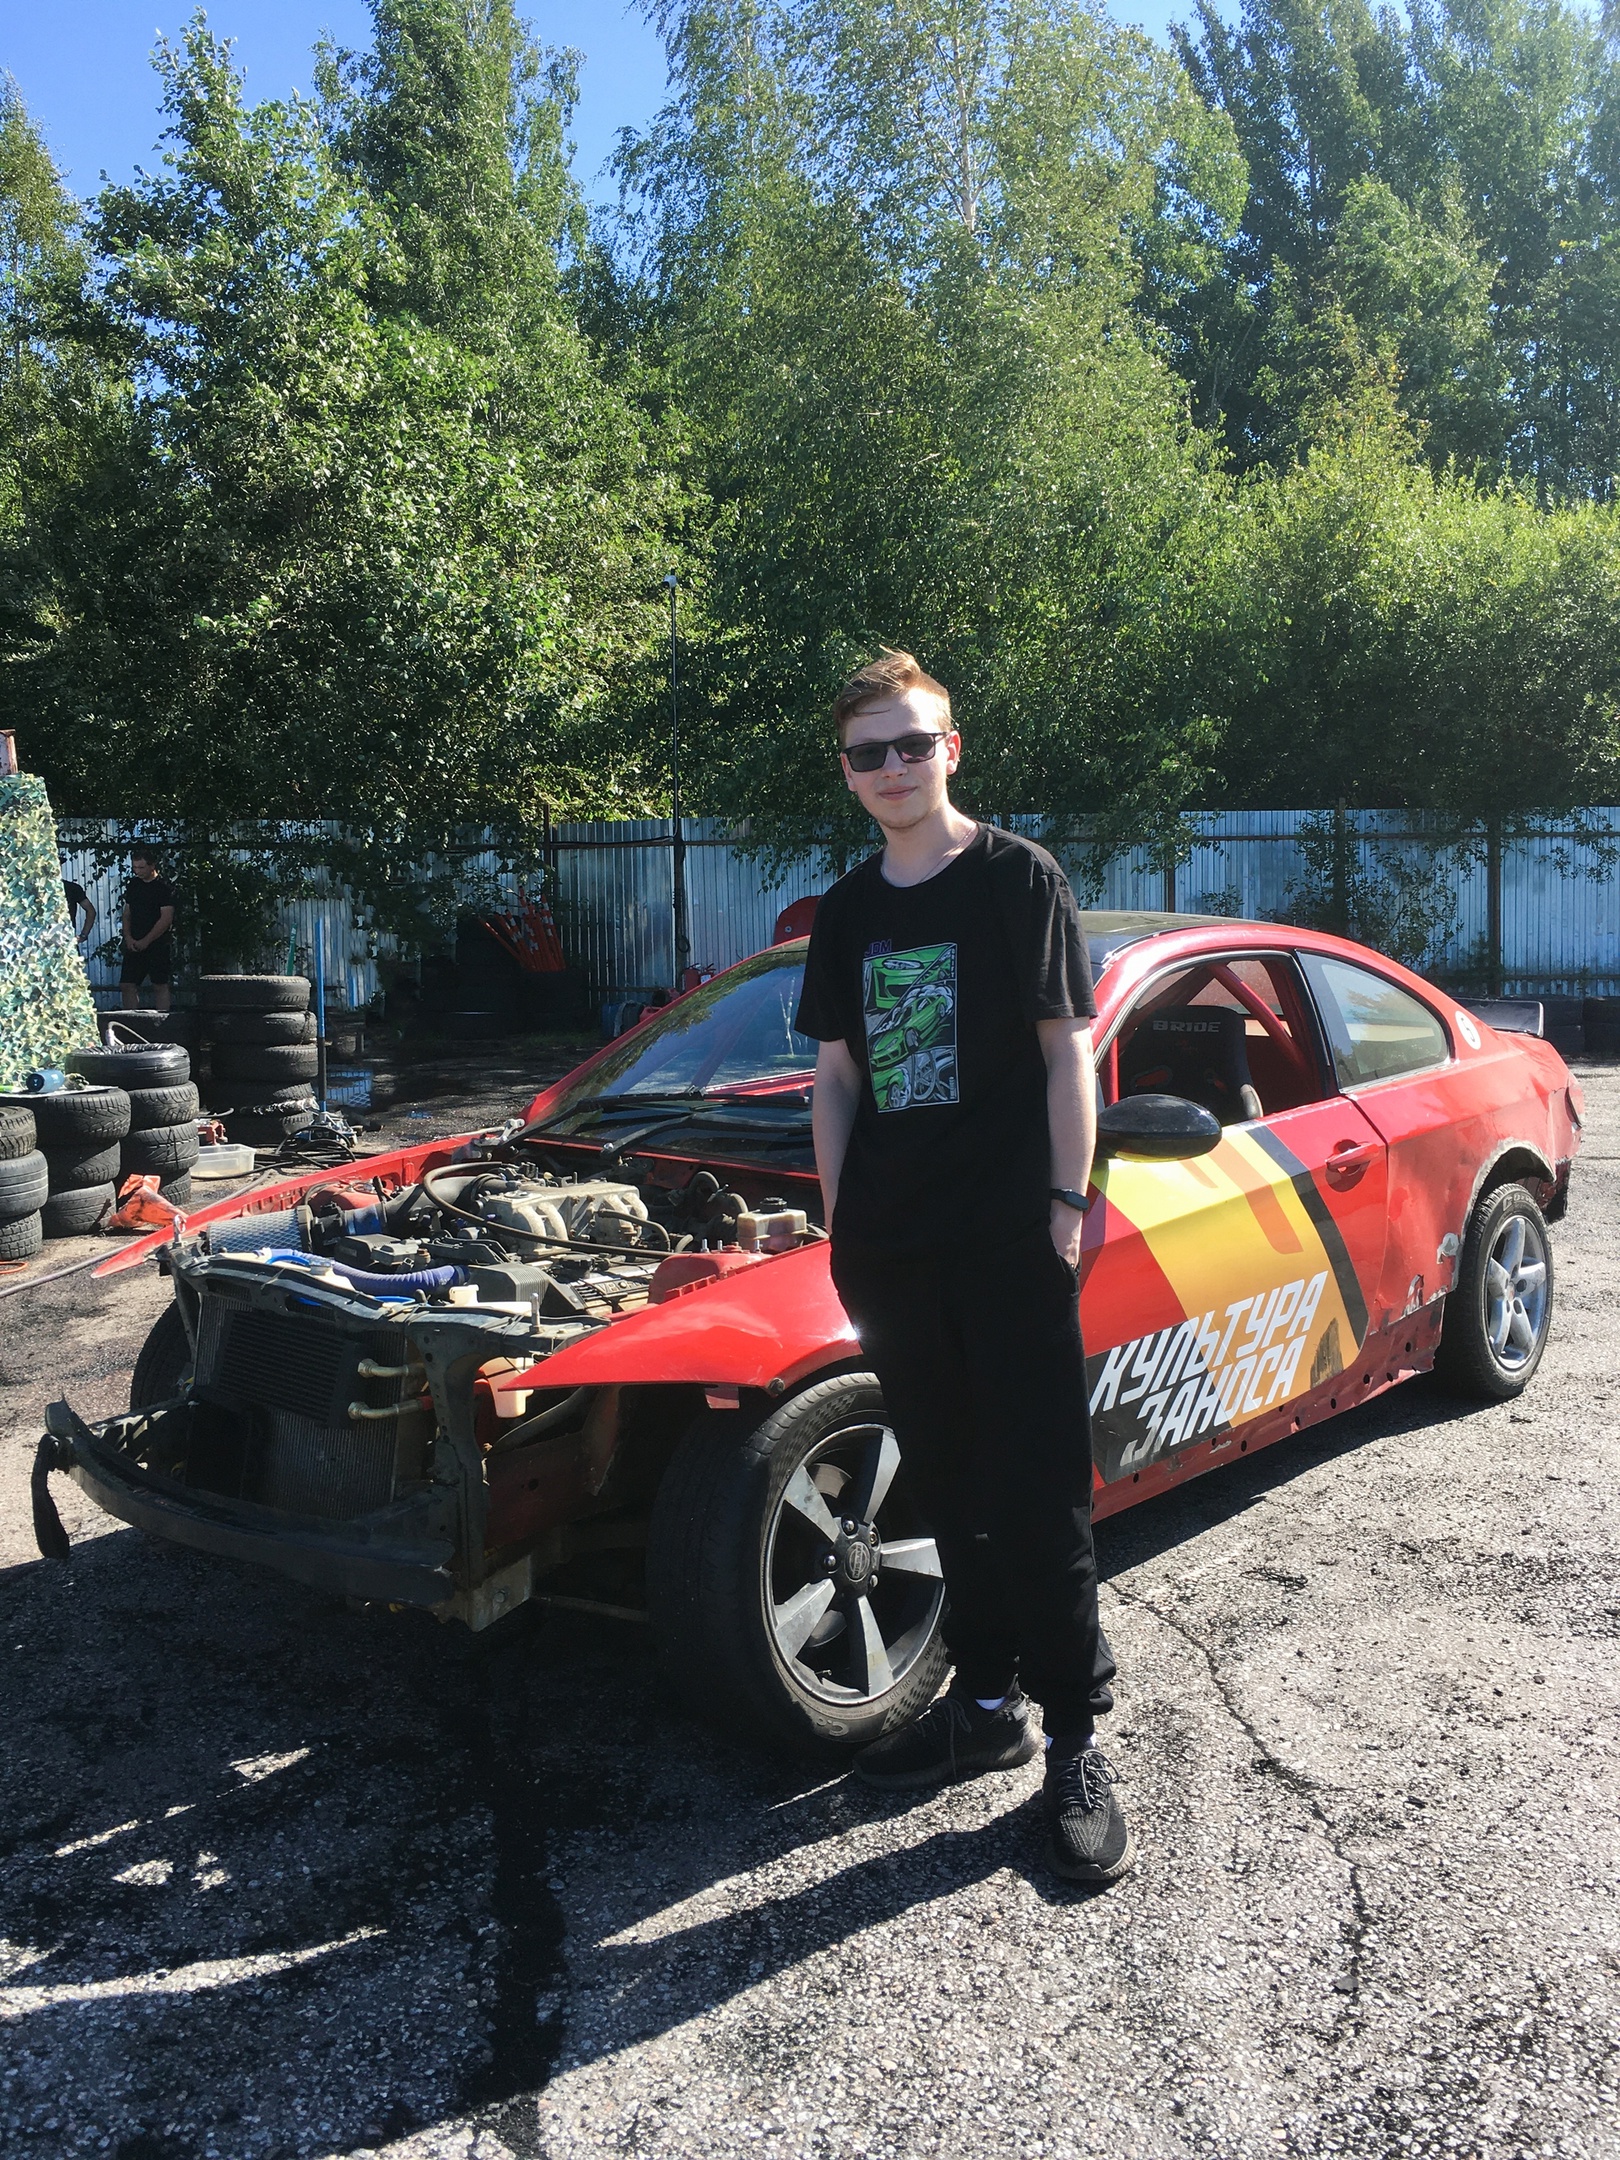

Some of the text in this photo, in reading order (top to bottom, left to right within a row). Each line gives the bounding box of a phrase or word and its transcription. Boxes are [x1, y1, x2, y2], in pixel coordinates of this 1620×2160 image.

[864, 938, 892, 957] JDM
[1153, 1020, 1221, 1032] BRIDE
[1089, 1270, 1329, 1416] КУЛЬТУРА
[1120, 1335, 1307, 1467] ЗАНОСА
[853, 1543, 863, 1577] NISSAN
